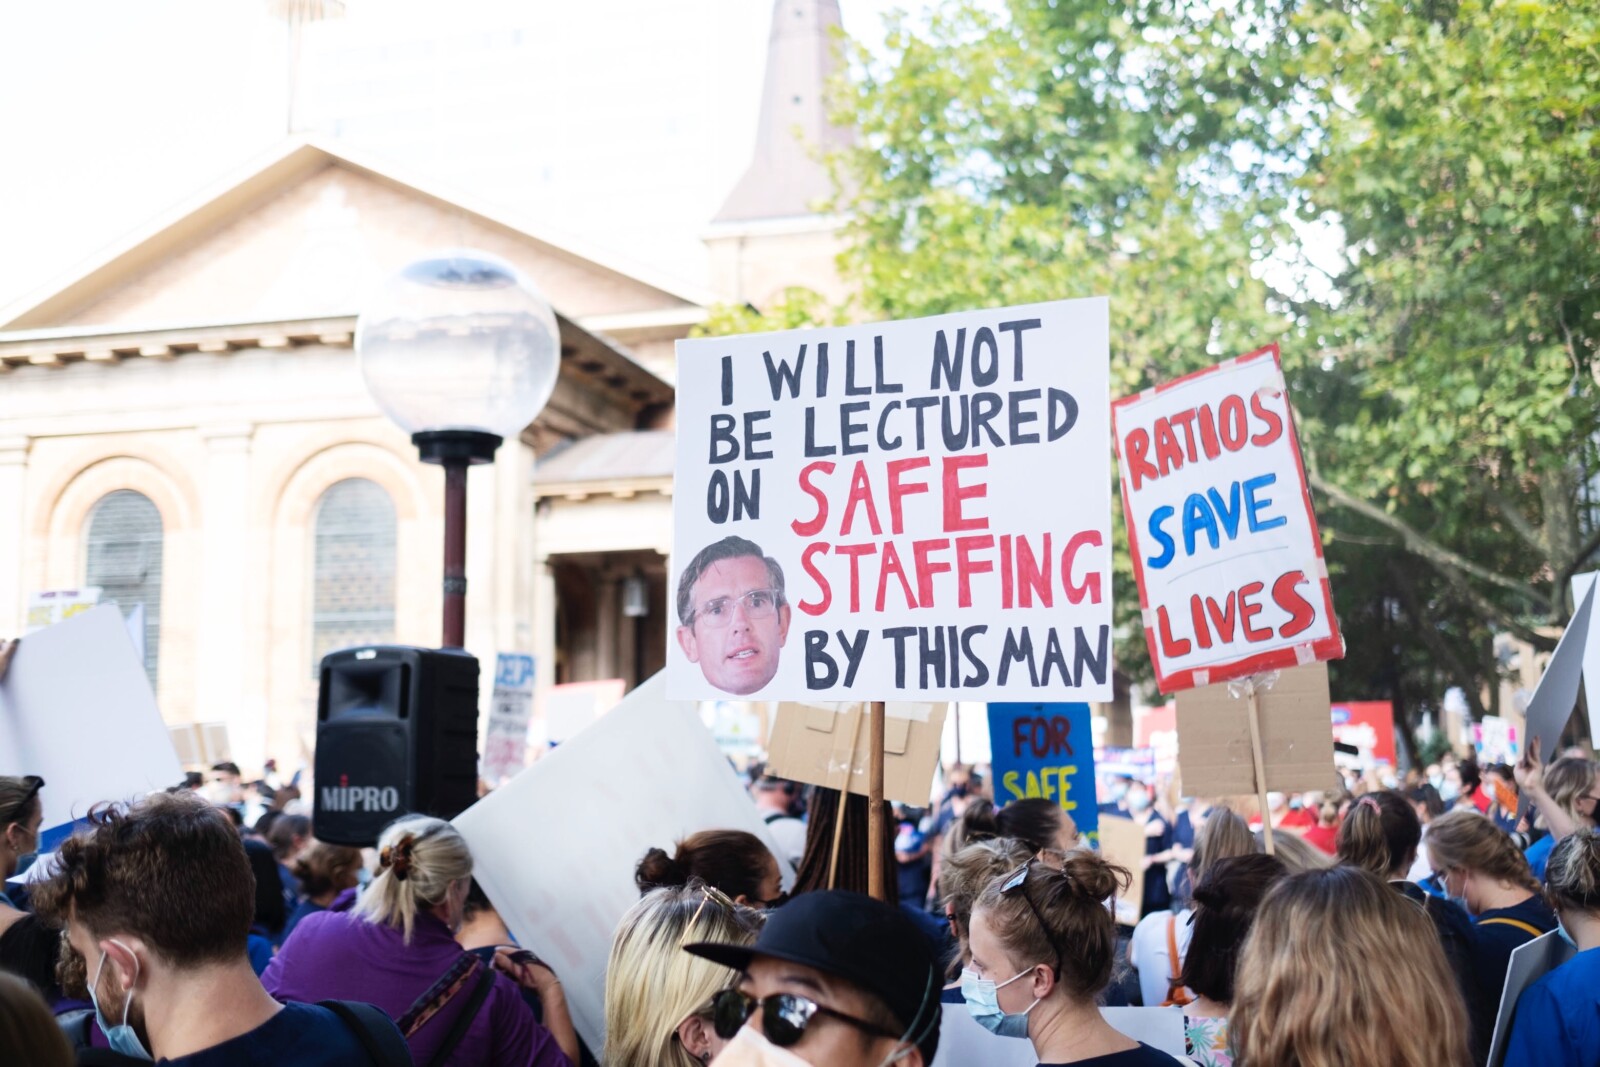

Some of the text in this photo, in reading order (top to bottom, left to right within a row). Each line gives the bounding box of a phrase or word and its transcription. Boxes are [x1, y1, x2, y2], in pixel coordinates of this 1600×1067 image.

[721, 318, 1041, 406] I WILL NOT
[709, 387, 1079, 464] BE LECTURED
[1124, 387, 1283, 492] RATIOS
[707, 453, 989, 537] ON SAFE
[1147, 473, 1287, 569] SAVE
[797, 530, 1103, 617] STAFFING
[1156, 570, 1316, 659] LIVES
[804, 625, 1109, 690] BY THIS MAN
[1013, 715, 1073, 758] FOR
[1003, 765, 1077, 810] SAFE
